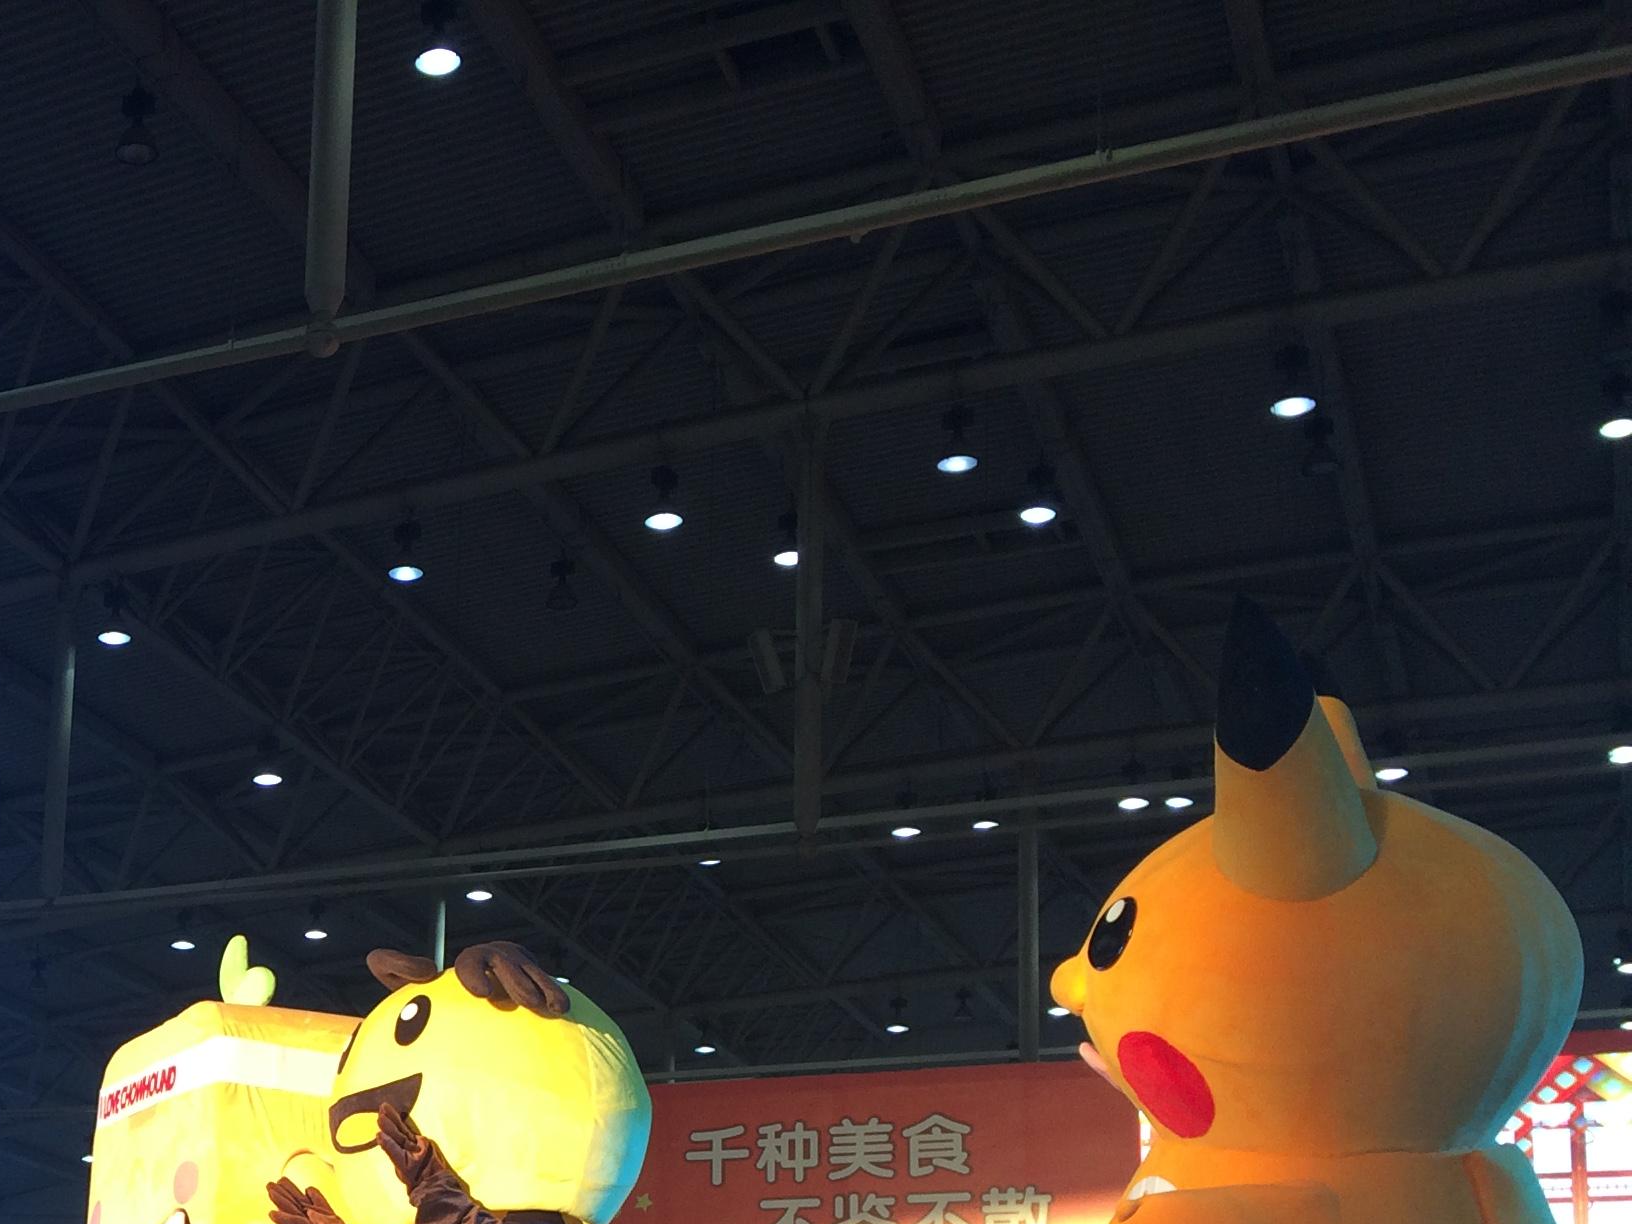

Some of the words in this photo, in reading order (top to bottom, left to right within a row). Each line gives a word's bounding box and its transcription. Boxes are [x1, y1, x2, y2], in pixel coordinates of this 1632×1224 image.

[104, 1090, 121, 1119] LOVE
[121, 1065, 177, 1109] CHOWHOUND
[685, 1113, 972, 1185] 千种美食
